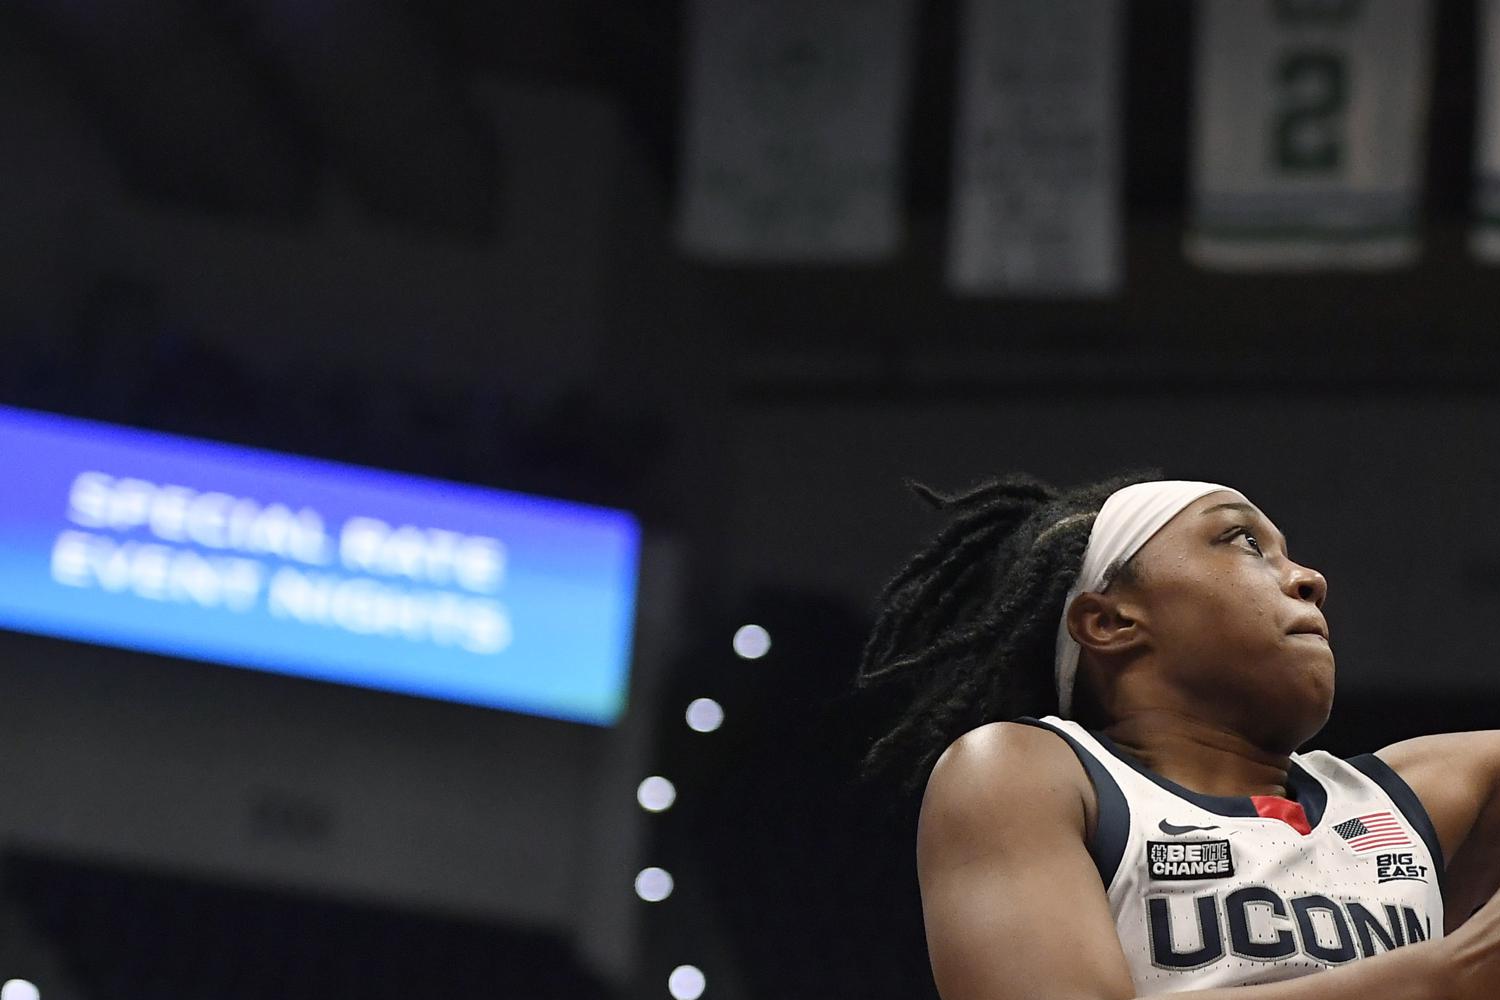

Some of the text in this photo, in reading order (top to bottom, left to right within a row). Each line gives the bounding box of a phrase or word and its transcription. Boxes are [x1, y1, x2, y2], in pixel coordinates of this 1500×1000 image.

[1270, 50, 1348, 174] 2
[50, 529, 264, 614] EVENT
[66, 470, 508, 594] SPECIAL RATE
[1152, 860, 1230, 875] CHANGE
[1376, 853, 1413, 867] BIG
[1377, 865, 1428, 878] EAST
[1145, 885, 1431, 971] UCONN
